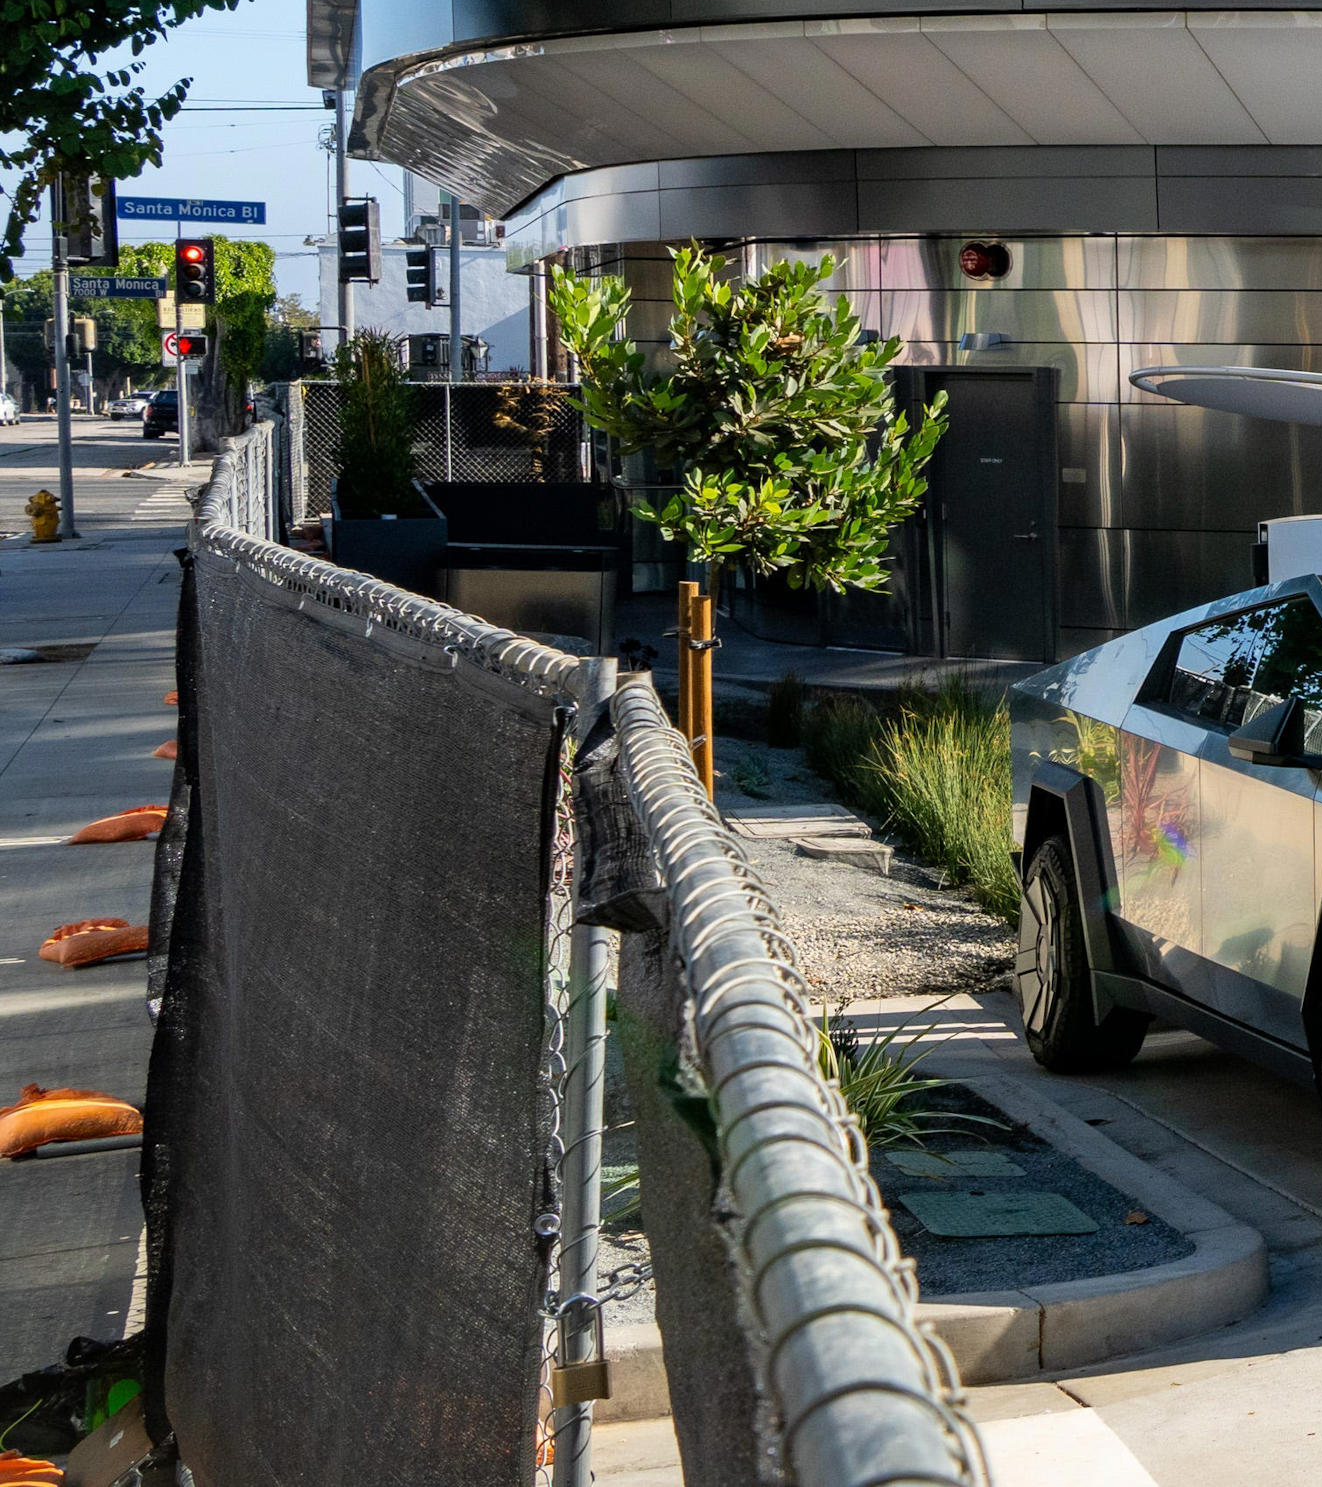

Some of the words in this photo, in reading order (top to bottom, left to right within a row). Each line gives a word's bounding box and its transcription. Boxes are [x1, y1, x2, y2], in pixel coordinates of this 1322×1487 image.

[124, 201, 173, 215] Santa
[179, 204, 236, 218] Monica
[73, 278, 110, 289] Santa
[116, 278, 160, 290] Monica
[73, 289, 97, 297] 7000
[99, 289, 107, 297] W
